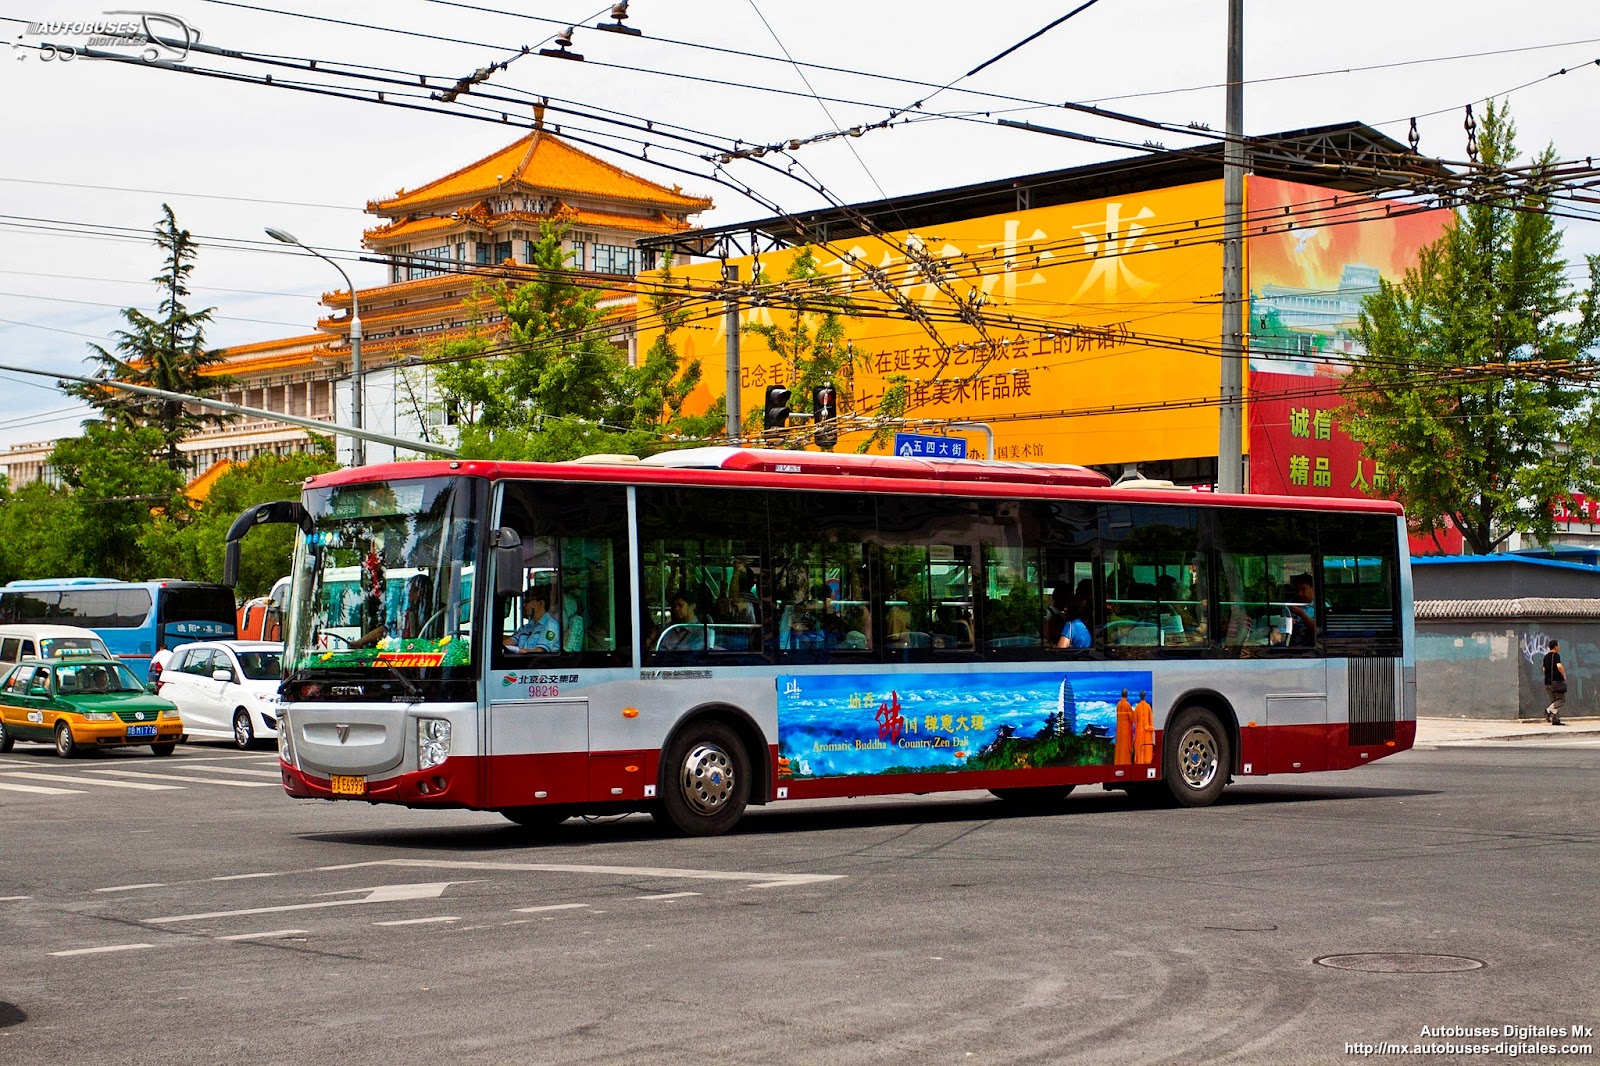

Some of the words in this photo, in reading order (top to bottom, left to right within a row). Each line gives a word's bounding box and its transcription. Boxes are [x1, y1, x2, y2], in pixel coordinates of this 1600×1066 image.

[1289, 407, 1332, 440] 诚信
[913, 440, 962, 457] 五四大街
[994, 443, 1044, 460] 国美术馆
[1289, 454, 1332, 487] 精品
[518, 674, 579, 685] 北京公交集团
[528, 685, 559, 698] 98216
[813, 739, 852, 753] Aromatic
[855, 738, 887, 751] Buddha
[952, 735, 969, 748] Dali
